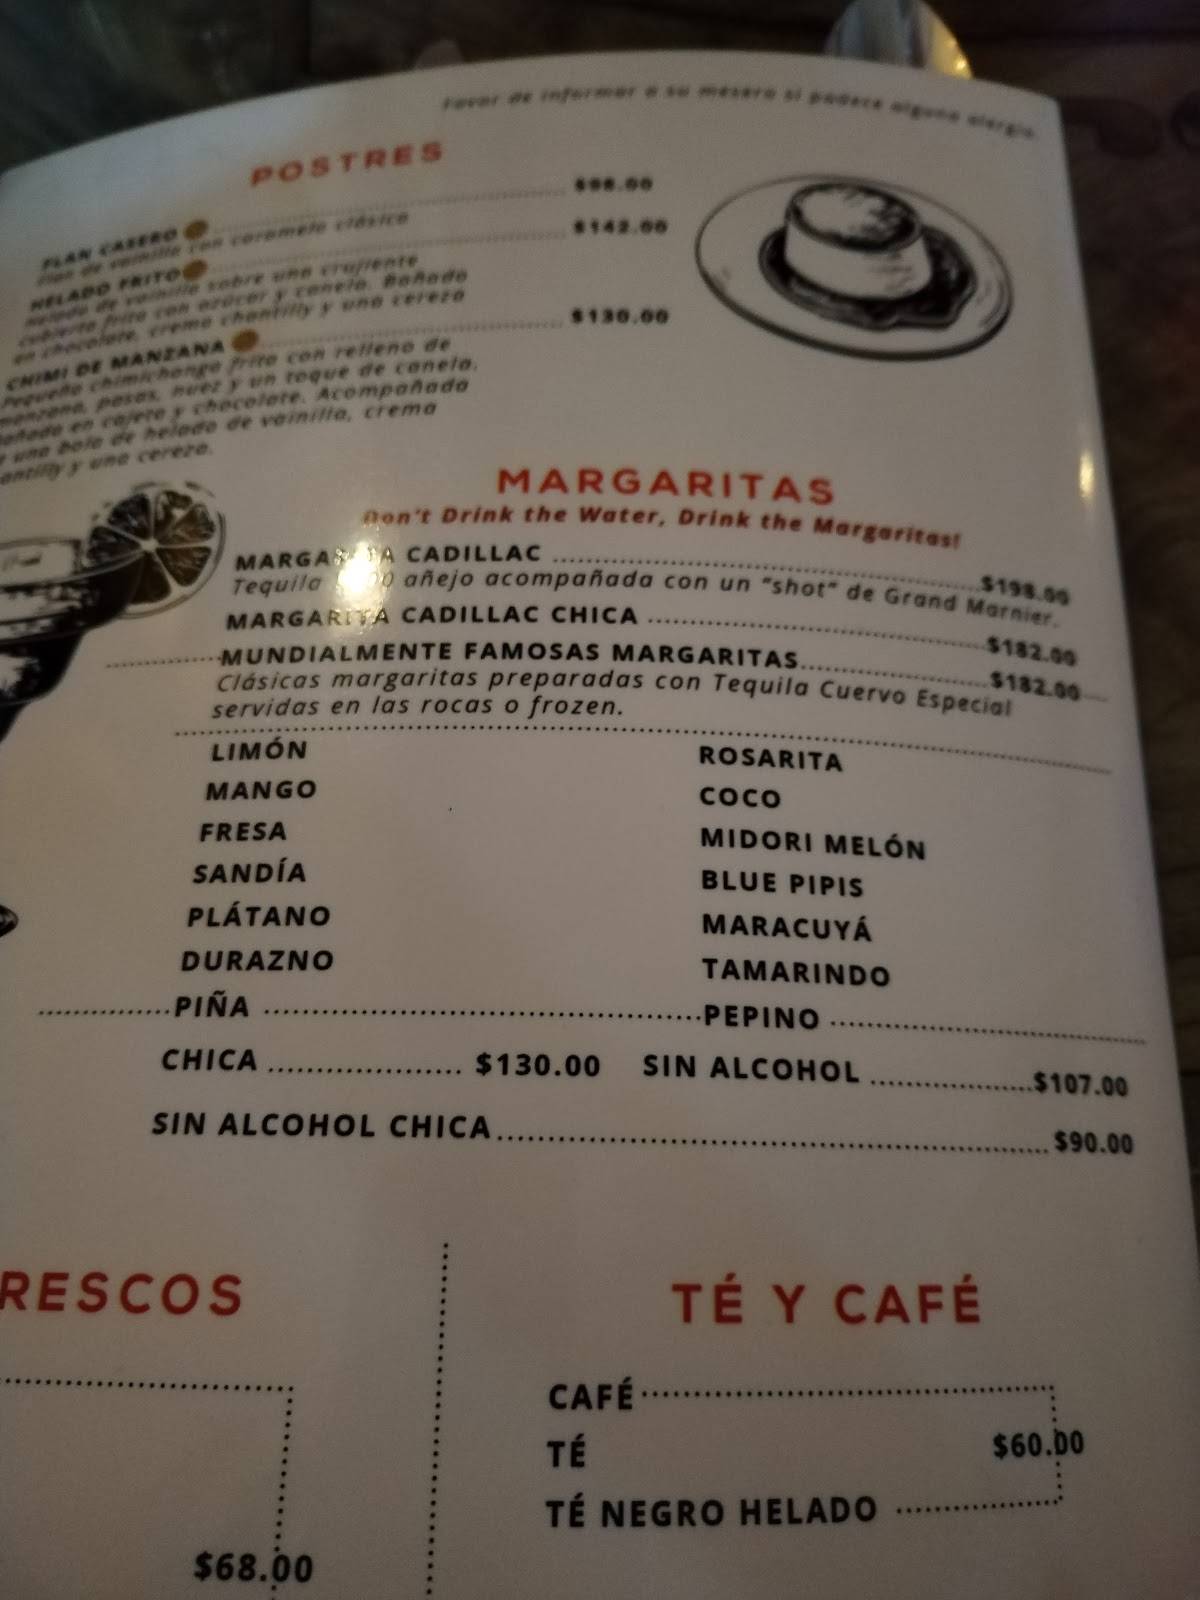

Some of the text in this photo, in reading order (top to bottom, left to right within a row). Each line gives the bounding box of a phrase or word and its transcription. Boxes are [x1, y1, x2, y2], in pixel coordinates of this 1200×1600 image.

[250, 141, 443, 188] POSTRES
[573, 217, 668, 236] $142.00
[75, 359, 102, 378] DE
[110, 338, 225, 371] MANZANA
[571, 306, 670, 326] $130.00
[497, 466, 835, 506] MARGARITAS
[362, 504, 962, 551] Don't Drink the Water, Drink the Margaritas!
[232, 574, 322, 600] Tequila
[404, 569, 475, 594] añejo
[484, 569, 655, 594] acompañada
[664, 575, 708, 593] con
[719, 576, 751, 594] un
[846, 582, 876, 602] de
[883, 587, 957, 613] Grand
[406, 544, 543, 564] CADILLAC
[980, 574, 1071, 607] $198.00
[226, 605, 1078, 668] MARGARITA CADILLAC CHICA $182.00
[221, 641, 1082, 702] MUNDIALMENTE FAMOSAS MARGARITAS $182.00
[210, 694, 624, 721] servidas en las rocas o frozen.
[216, 667, 1013, 719] Clásicas margaritas preparadas con Tequila Cuervo Especial
[210, 735, 308, 762] LIMÓN
[698, 744, 845, 773] ROSARITA
[205, 779, 318, 802] MANGO
[698, 786, 782, 810] COCO
[198, 821, 288, 843] FRESA
[699, 826, 927, 861] MIDORI MELÓN
[191, 857, 307, 885] SANDÍA
[701, 869, 865, 899] BLUE PIPIS
[187, 900, 332, 929] PLÁTANO
[701, 912, 873, 943] MARACUYÁ
[180, 949, 335, 973] DURAZNO
[702, 956, 891, 988] TAMARINDO
[174, 989, 250, 1019] PIÑA
[703, 1003, 820, 1031] PEPINO
[160, 1047, 1129, 1098] CHICA $130.00 SIN ALCOHOL $107.00
[151, 1111, 1135, 1156] SIN ALCOHOL CHICA $90.00
[0, 1270, 243, 1317] RESCOS
[671, 1271, 983, 1325] TÉ Y CAFÉ
[548, 1375, 634, 1411] CAFÉ
[546, 1429, 1087, 1469] TÉ $60.00
[545, 1491, 878, 1530] TÉ NEGRO HELADO
[194, 1550, 313, 1584] $68.00
